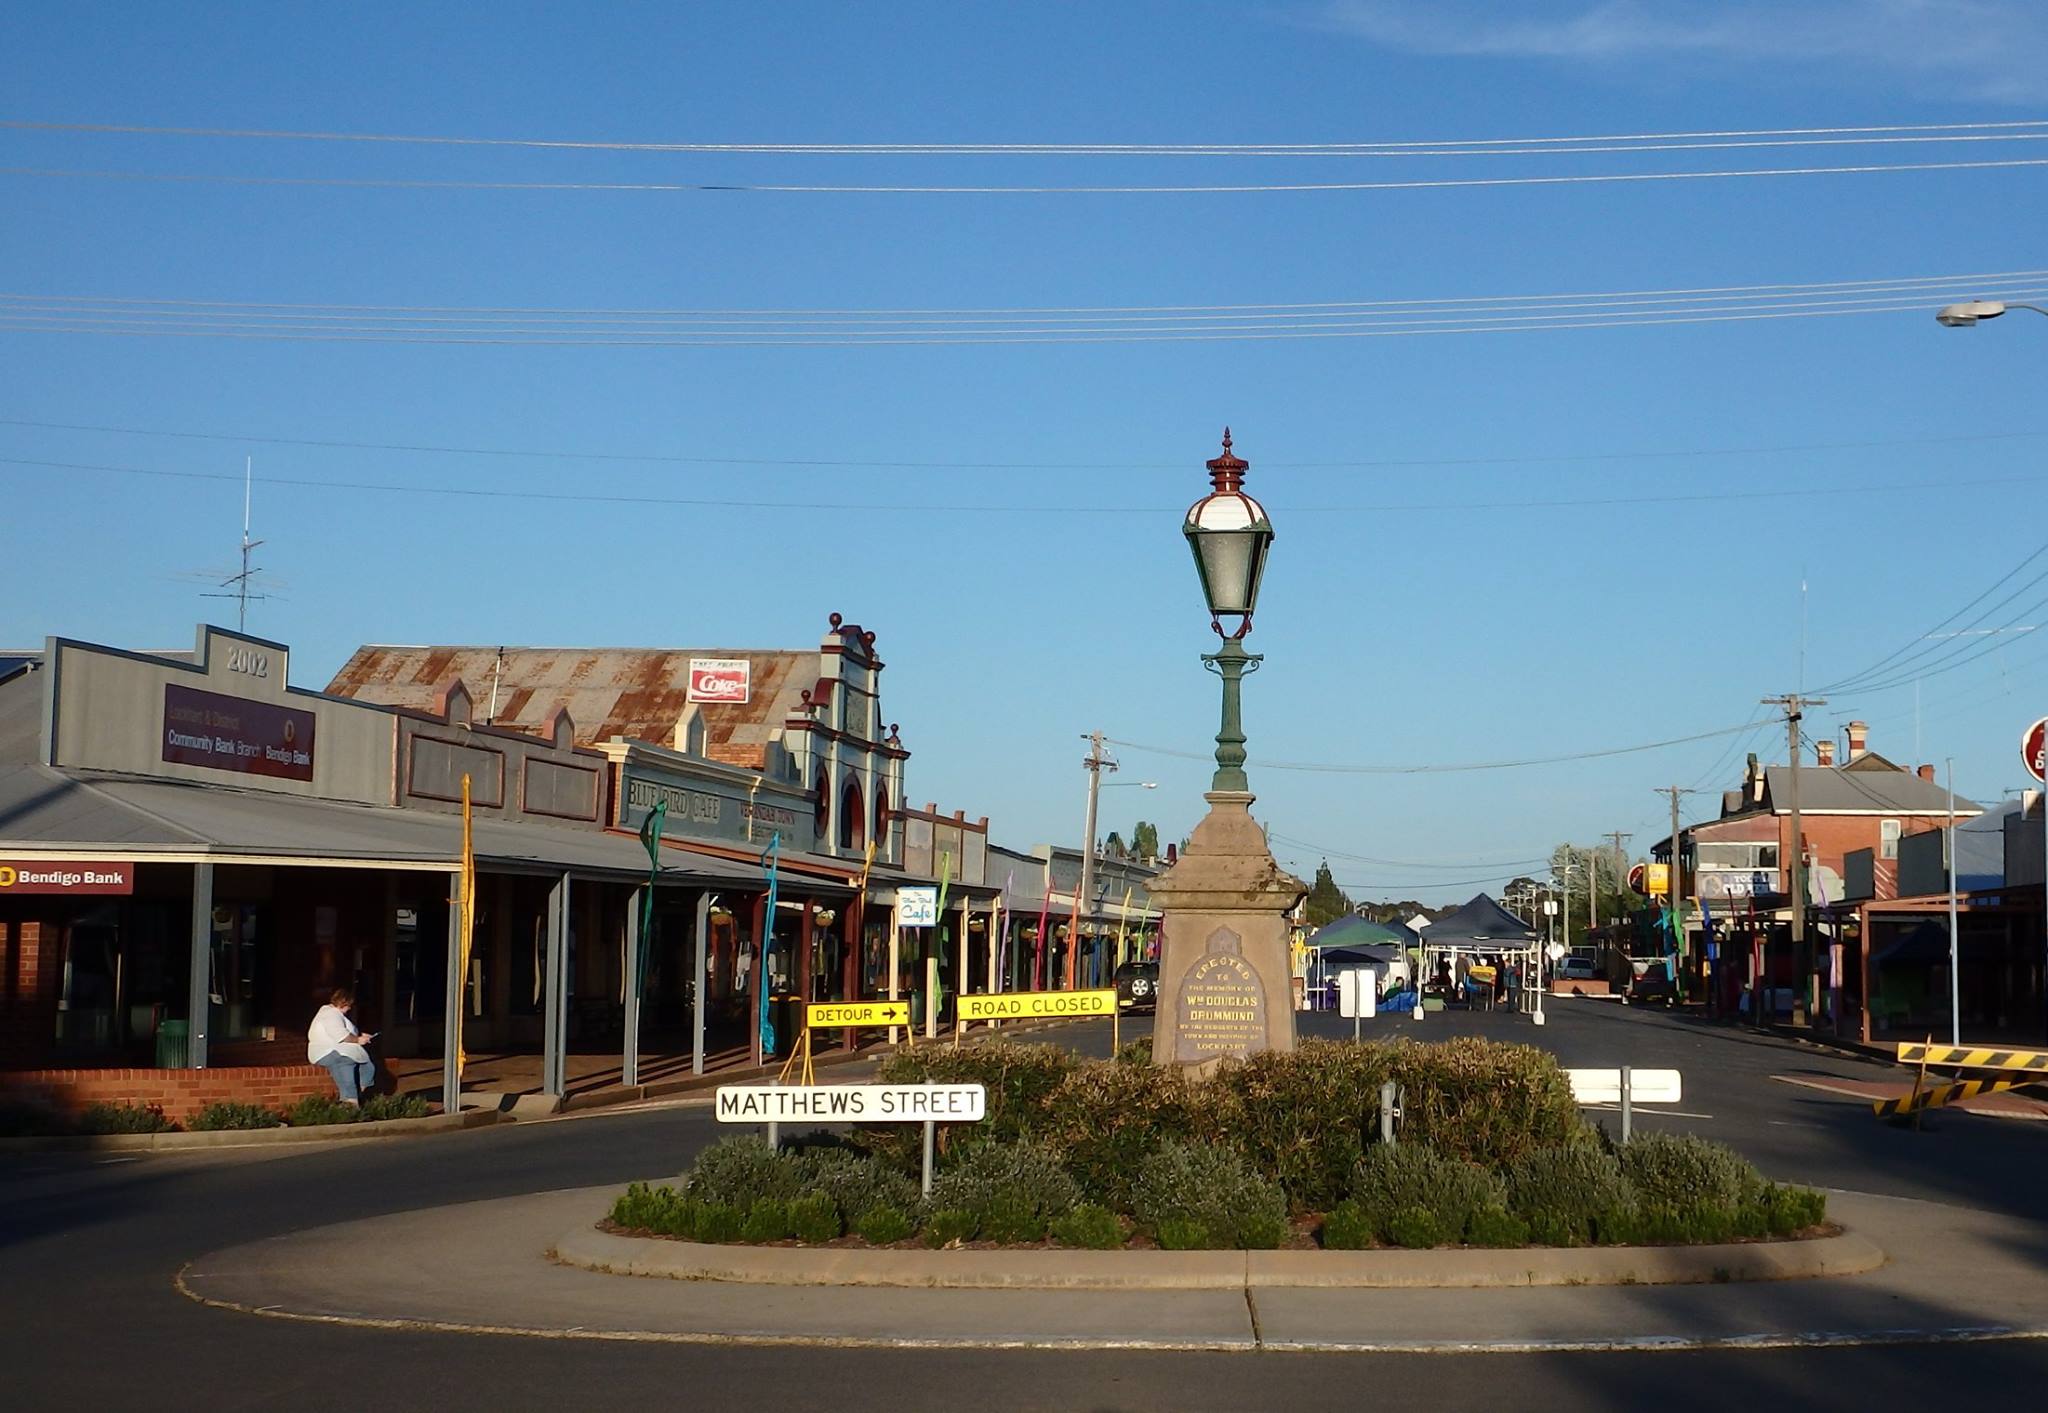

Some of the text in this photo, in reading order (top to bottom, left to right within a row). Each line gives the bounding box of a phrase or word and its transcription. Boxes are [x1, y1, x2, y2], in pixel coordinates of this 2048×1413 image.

[228, 647, 268, 678] 2002
[699, 675, 738, 692] Coke
[168, 729, 213, 753] Community
[215, 737, 236, 754] Bank
[265, 745, 310, 765] Bendigo Bank
[628, 782, 720, 819] BLUE BIRD CAFE
[18, 870, 123, 886] Bendigo Bank
[901, 904, 933, 922] Cafe
[1195, 956, 1250, 980] ERECTED
[1216, 973, 1229, 981] TO
[971, 997, 1103, 1015] ROAD CLOSED
[1206, 996, 1258, 1007] DOUGLAS
[816, 1009, 873, 1021] DETOUR
[1190, 1011, 1254, 1021] DRUMMOND
[720, 1091, 979, 1115] MATTHEWS STREET
